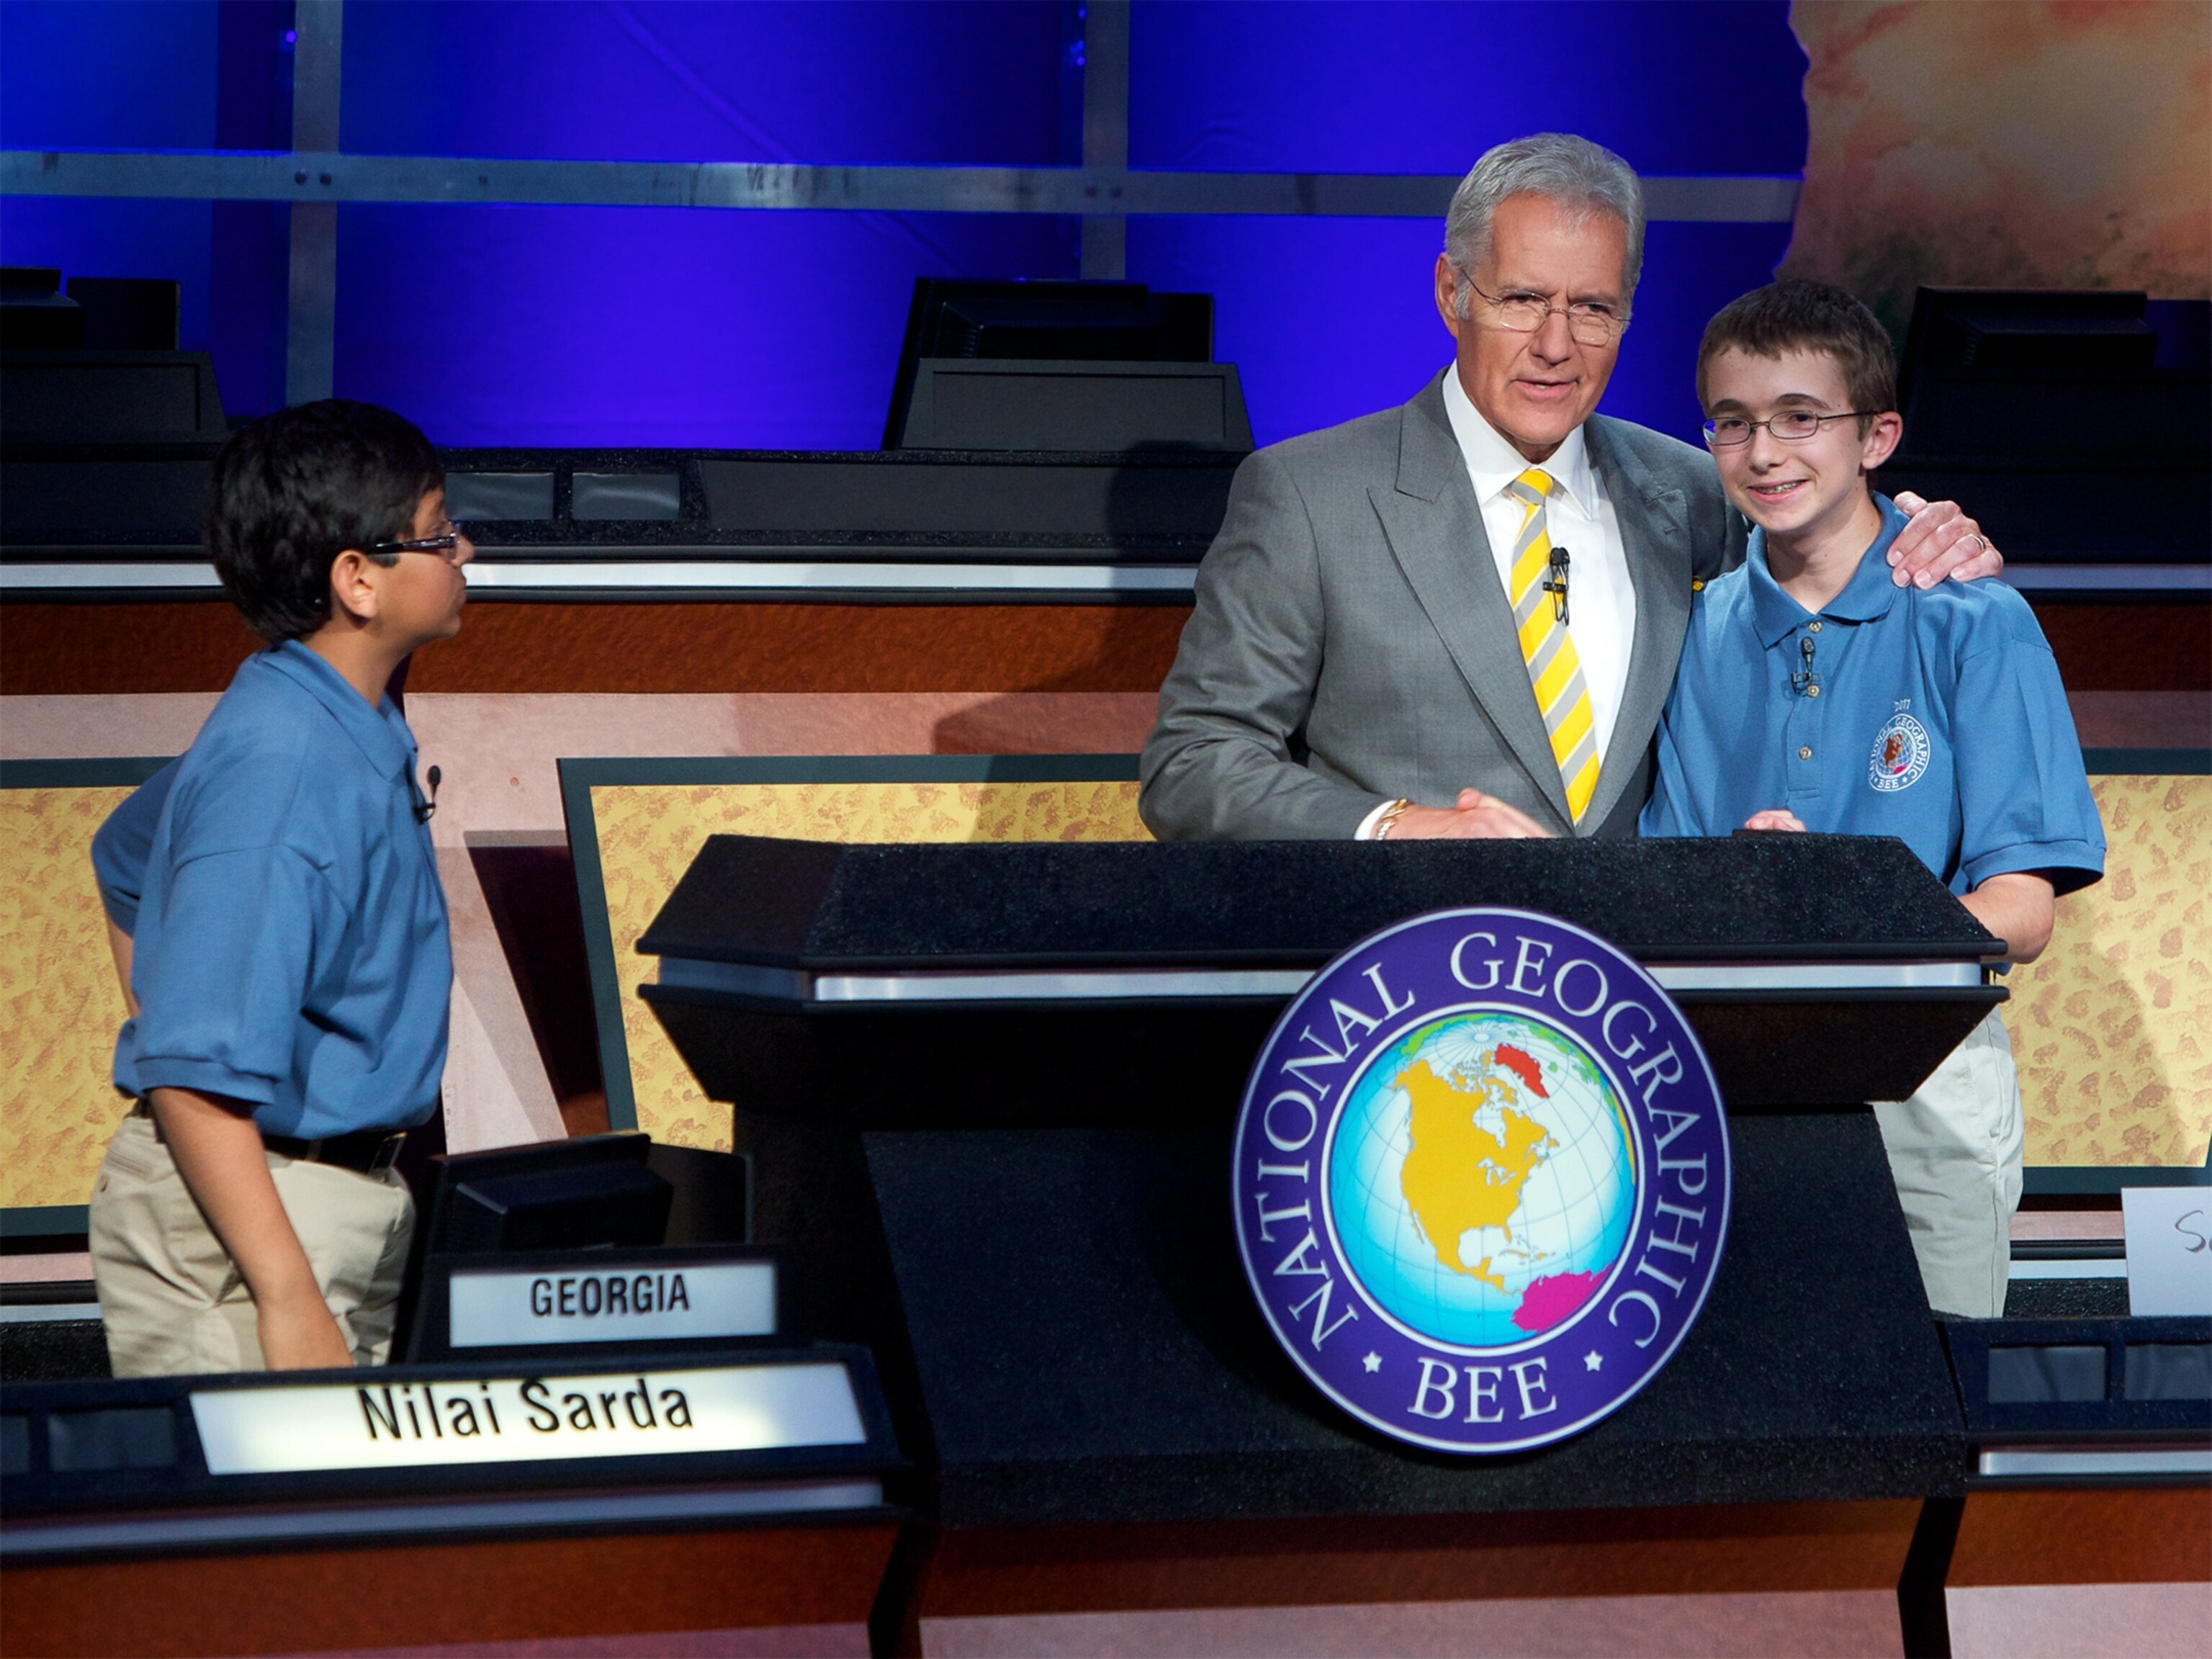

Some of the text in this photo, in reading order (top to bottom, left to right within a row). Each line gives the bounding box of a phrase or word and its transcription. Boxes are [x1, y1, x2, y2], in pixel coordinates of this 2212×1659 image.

[1894, 716, 1928, 779] GEOGRAPHIC
[1877, 778, 1899, 789] BEE
[1255, 932, 1708, 1352] NATIONAL GEOGRAPHIC
[2175, 1209, 2212, 1254] S
[531, 1274, 690, 1317] GEORGIA
[359, 1377, 693, 1440] Nilai Sarda
[1406, 1356, 1558, 1424] BEE
